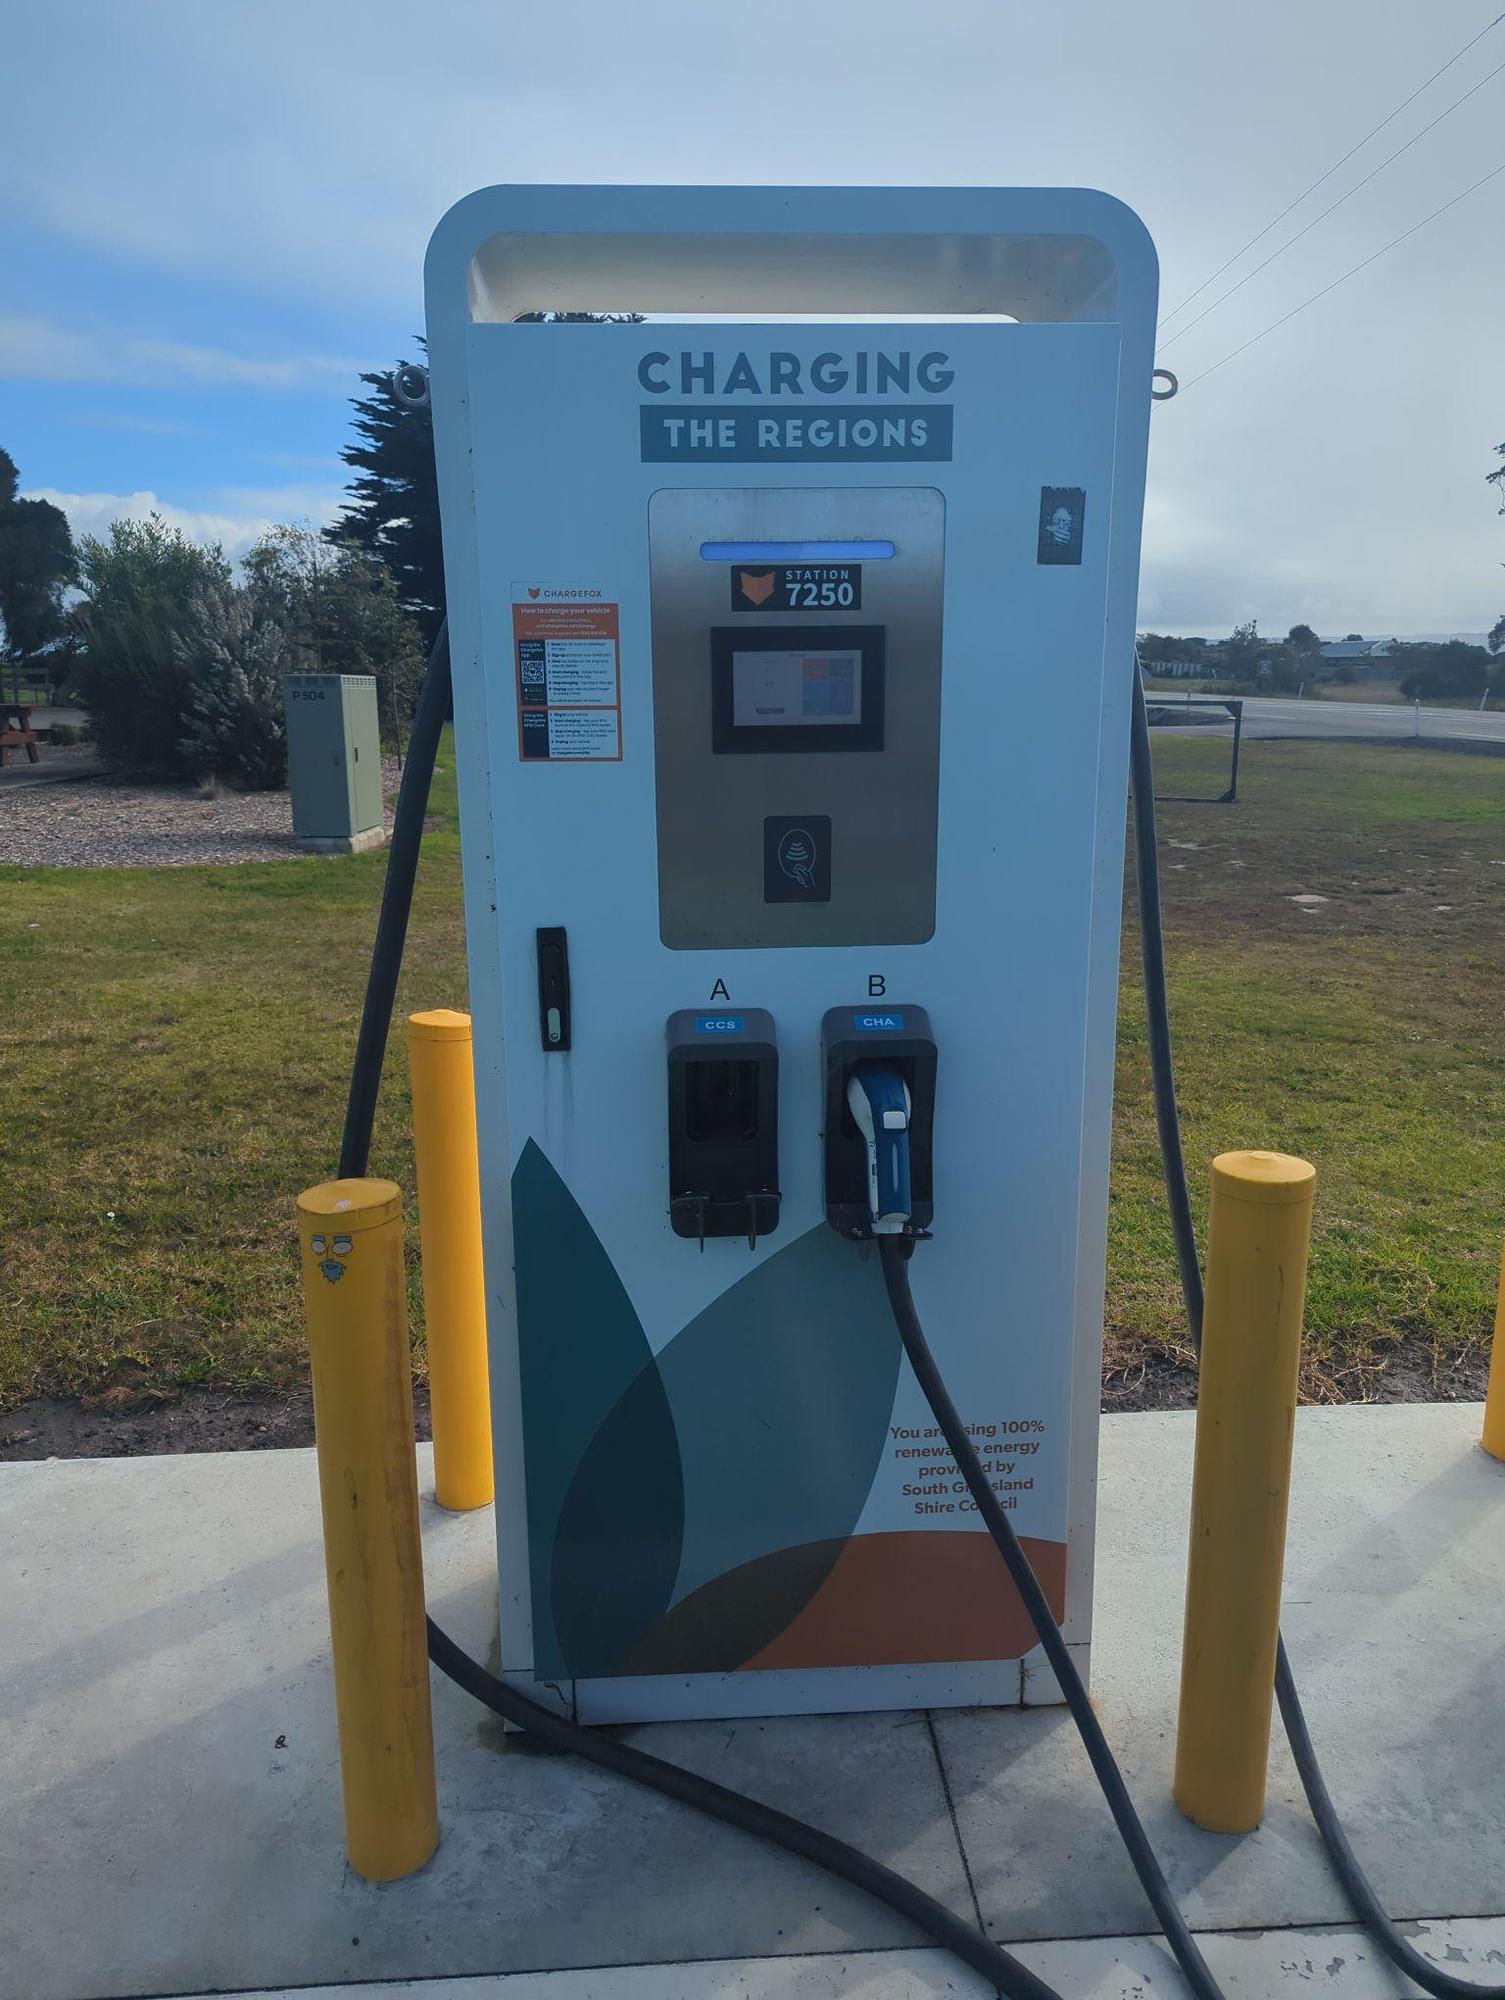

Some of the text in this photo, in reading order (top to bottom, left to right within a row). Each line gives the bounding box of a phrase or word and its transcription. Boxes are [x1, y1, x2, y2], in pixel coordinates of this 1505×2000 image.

[637, 351, 955, 394] CHARGING
[663, 418, 928, 447] THE REGIONS
[785, 570, 849, 580] STATION
[543, 590, 602, 598] CHARGEFOX
[785, 582, 854, 606] 7250
[709, 978, 731, 1001] A
[868, 975, 886, 997] B
[704, 1021, 737, 1030] CCS
[863, 1018, 895, 1027] CHA
[890, 1426, 919, 1439] You
[964, 1423, 997, 1437] sing
[1001, 1420, 1045, 1434] 100%
[895, 1441, 1040, 1458] renewae energy
[918, 1460, 1016, 1479] provid by
[902, 1478, 1034, 1496] South Gisland
[914, 1497, 1018, 1515] Shire Cocil
